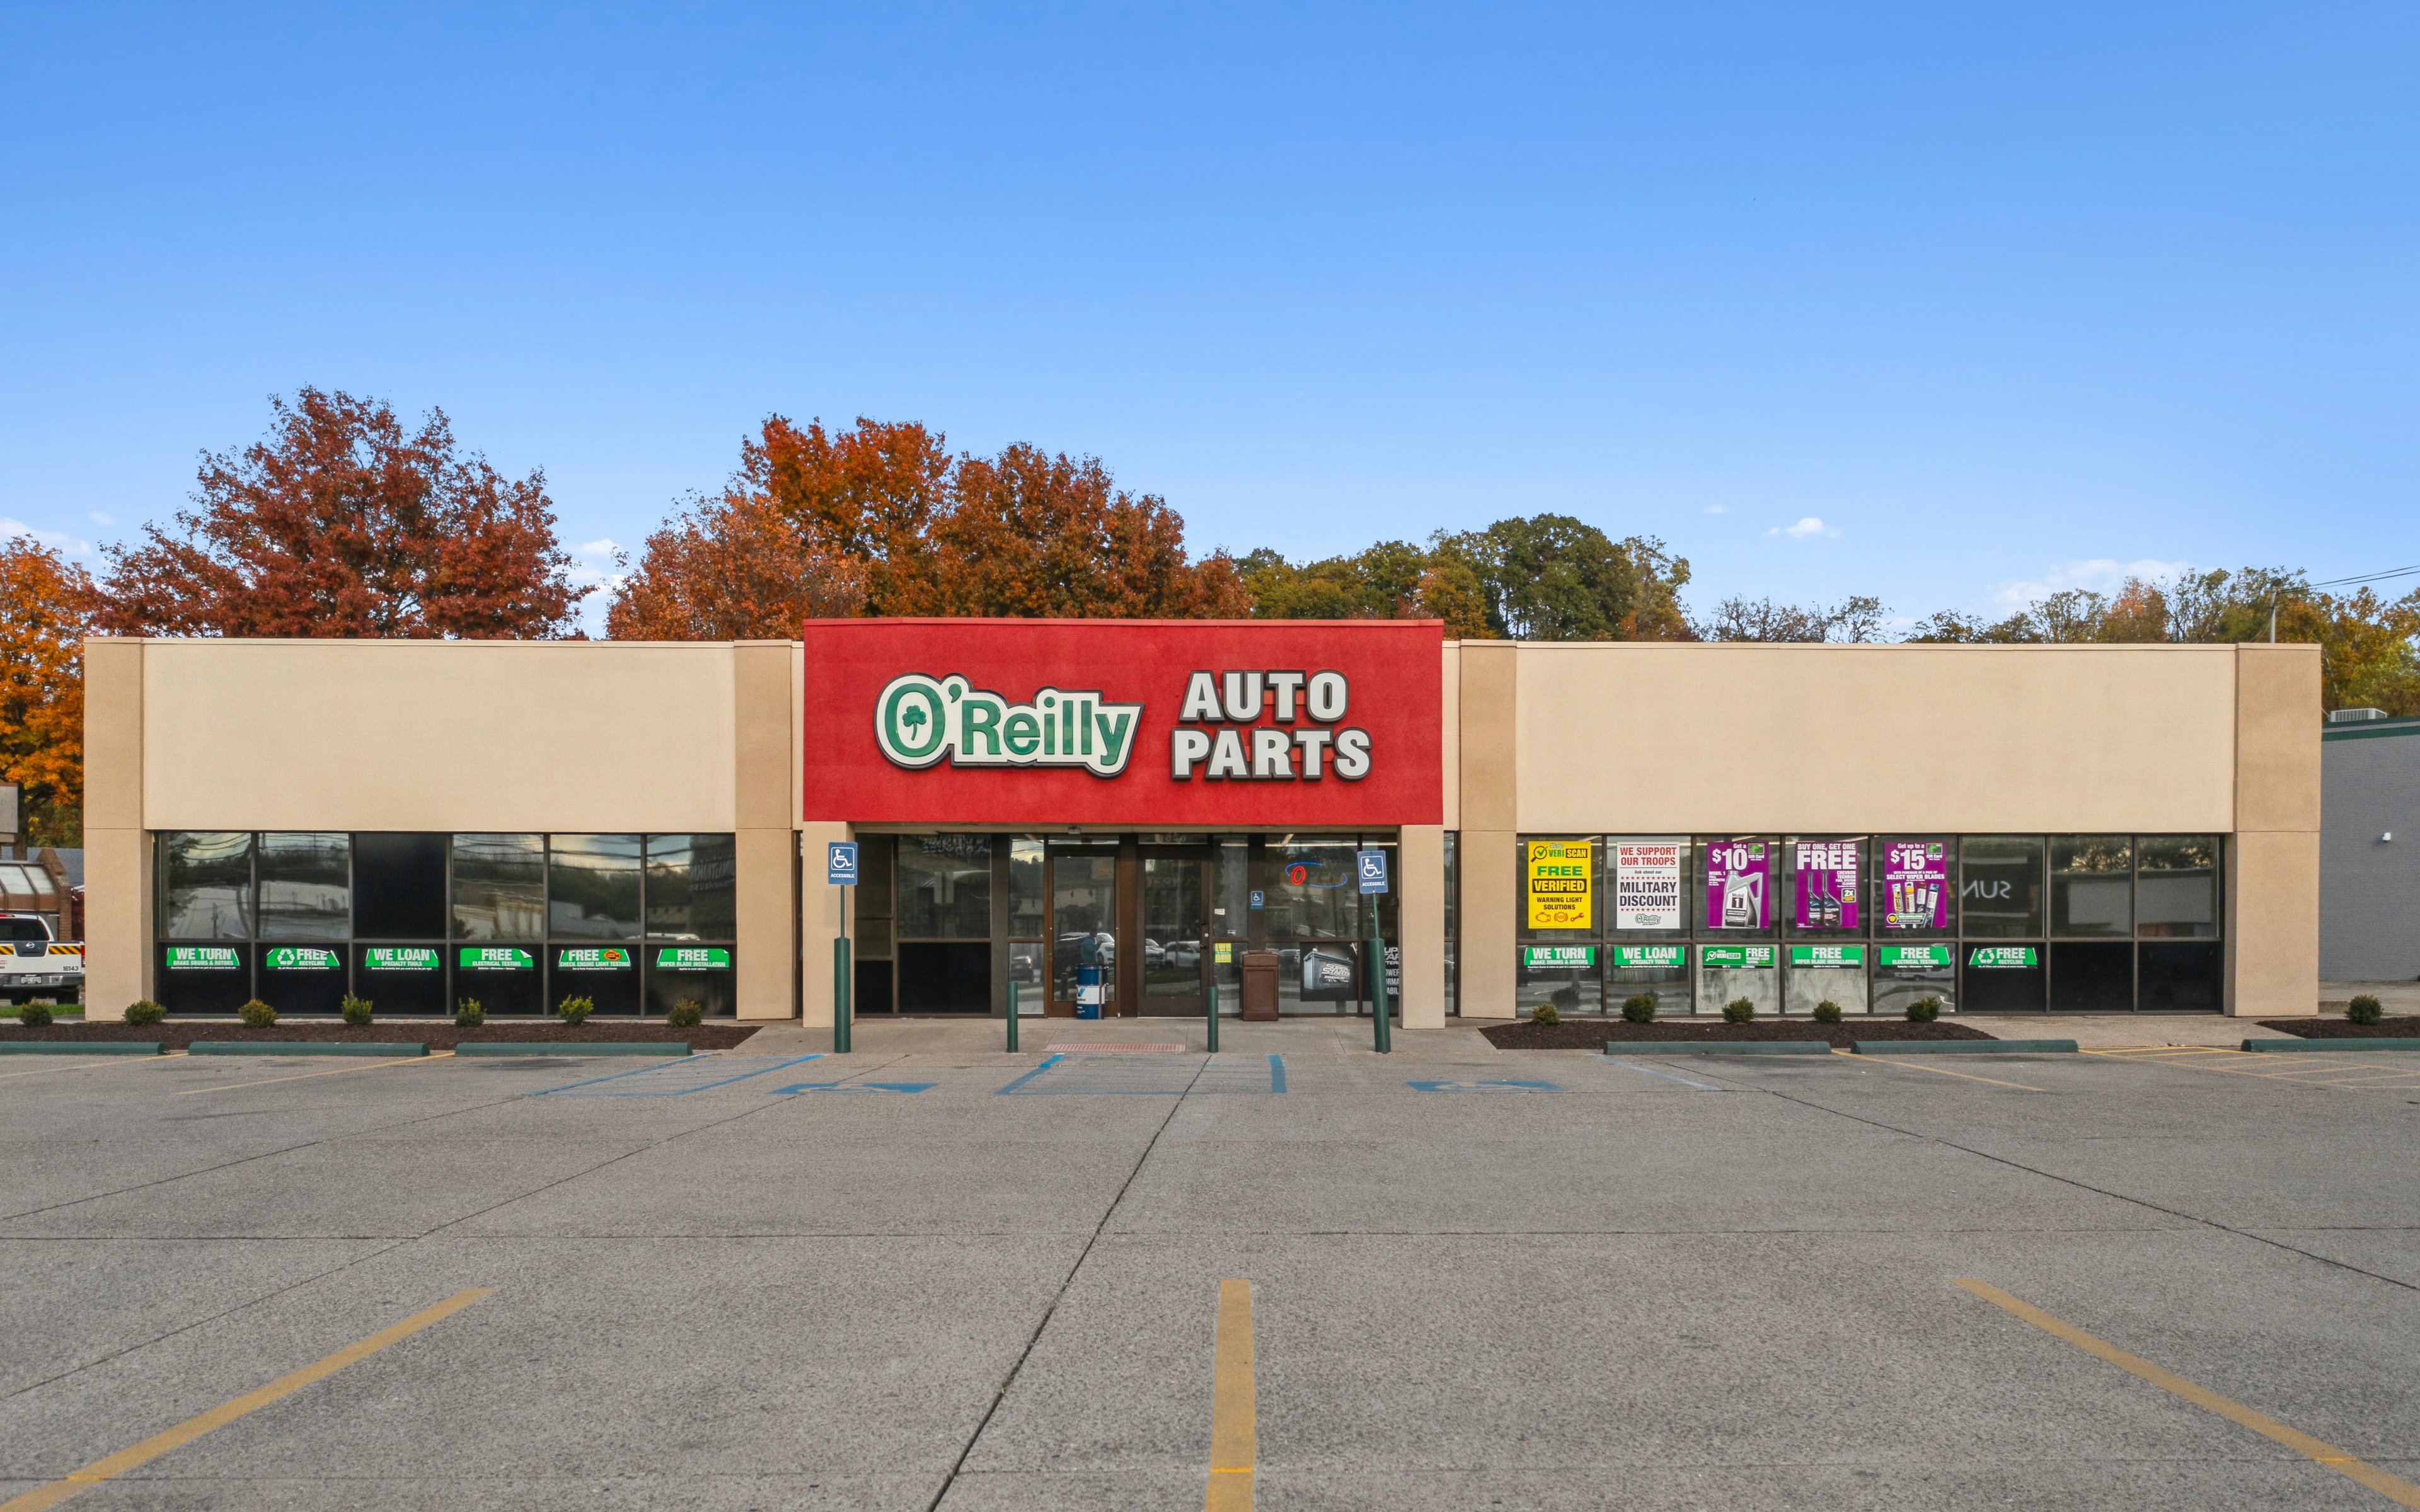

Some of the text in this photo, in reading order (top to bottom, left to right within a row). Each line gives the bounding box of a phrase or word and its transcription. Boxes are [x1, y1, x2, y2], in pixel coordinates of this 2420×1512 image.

[1180, 671, 1348, 720] AUTO
[885, 683, 1131, 766] O'Reilly
[1173, 729, 1371, 777] PARTS
[1548, 849, 1586, 857] VERI SCAN
[1620, 847, 1676, 856] WE SUPPORT
[1621, 857, 1676, 866] OUR TROOPS
[1712, 849, 1748, 870] $10
[1797, 850, 1856, 869] FREE
[1891, 849, 1925, 870] $15
[1537, 866, 1582, 876] FREE
[1534, 880, 1585, 891] VERIFIED
[1620, 882, 1676, 893] MILITARY
[1620, 895, 1677, 906] DISCOUNT
[176, 948, 231, 959] WE TURN
[297, 949, 328, 960] FREE
[374, 949, 430, 961] WE LOAN
[481, 949, 512, 960] FREE
[568, 949, 599, 961] FREE
[677, 949, 708, 961] FREE
[1532, 948, 1586, 959] WE TURN
[1622, 948, 1676, 959] WE LOAN
[1746, 948, 1770, 957] FREE
[1812, 948, 1841, 958] FREE
[1901, 948, 1930, 958] FREE
[1996, 948, 2025, 959] FREE
